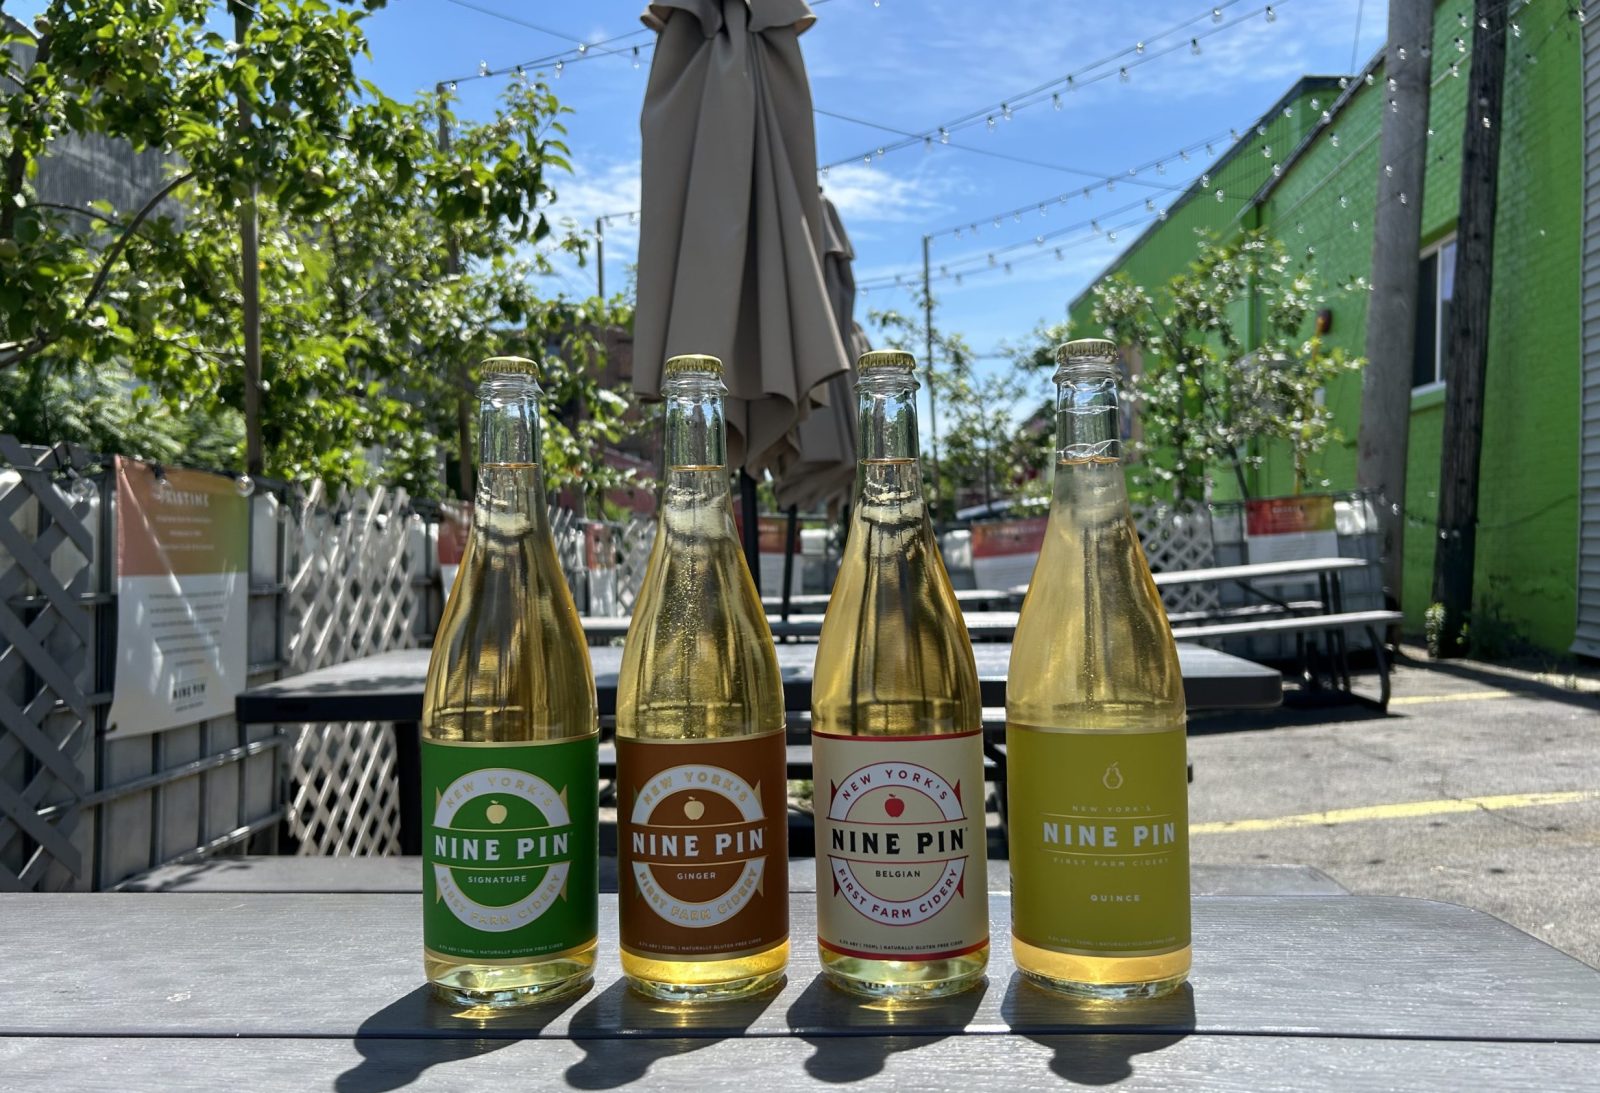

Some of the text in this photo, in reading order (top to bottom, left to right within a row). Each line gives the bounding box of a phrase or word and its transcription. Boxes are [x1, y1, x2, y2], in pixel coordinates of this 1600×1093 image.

[446, 781, 474, 808] NEW
[643, 776, 673, 805] NEW
[842, 769, 948, 800] NEW YORK'S
[435, 832, 568, 861] NINE PIN
[633, 828, 763, 857] NINE PIN
[832, 828, 963, 855] NINE PIN
[1043, 822, 1175, 847] NINE PIN
[468, 875, 527, 884] SIGNATURE
[677, 872, 716, 880] GINGER
[875, 870, 921, 878] BELGIAN
[639, 872, 668, 909] FIRST
[671, 906, 711, 920] FARM
[838, 868, 957, 919] FIRST FARM CIDERY
[1090, 894, 1141, 902] QUINCE
